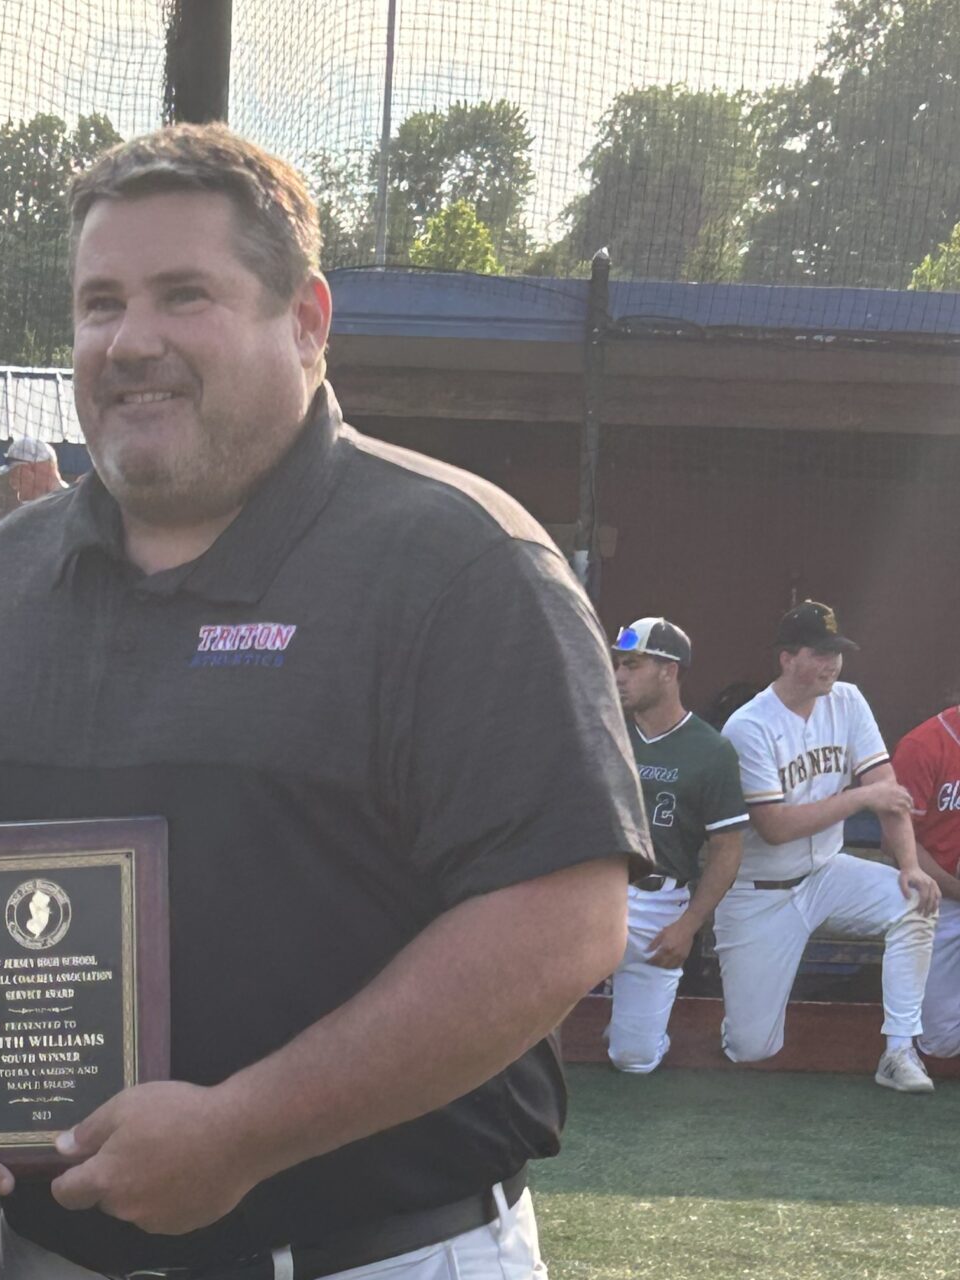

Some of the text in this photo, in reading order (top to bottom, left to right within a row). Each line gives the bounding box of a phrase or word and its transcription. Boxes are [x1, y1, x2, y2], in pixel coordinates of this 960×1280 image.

[197, 622, 297, 651] TRITON
[28, 1033, 105, 1048] WILLIAMS
[1, 1051, 81, 1064] SOUTH WINNER
[77, 1065, 99, 1075] AND
